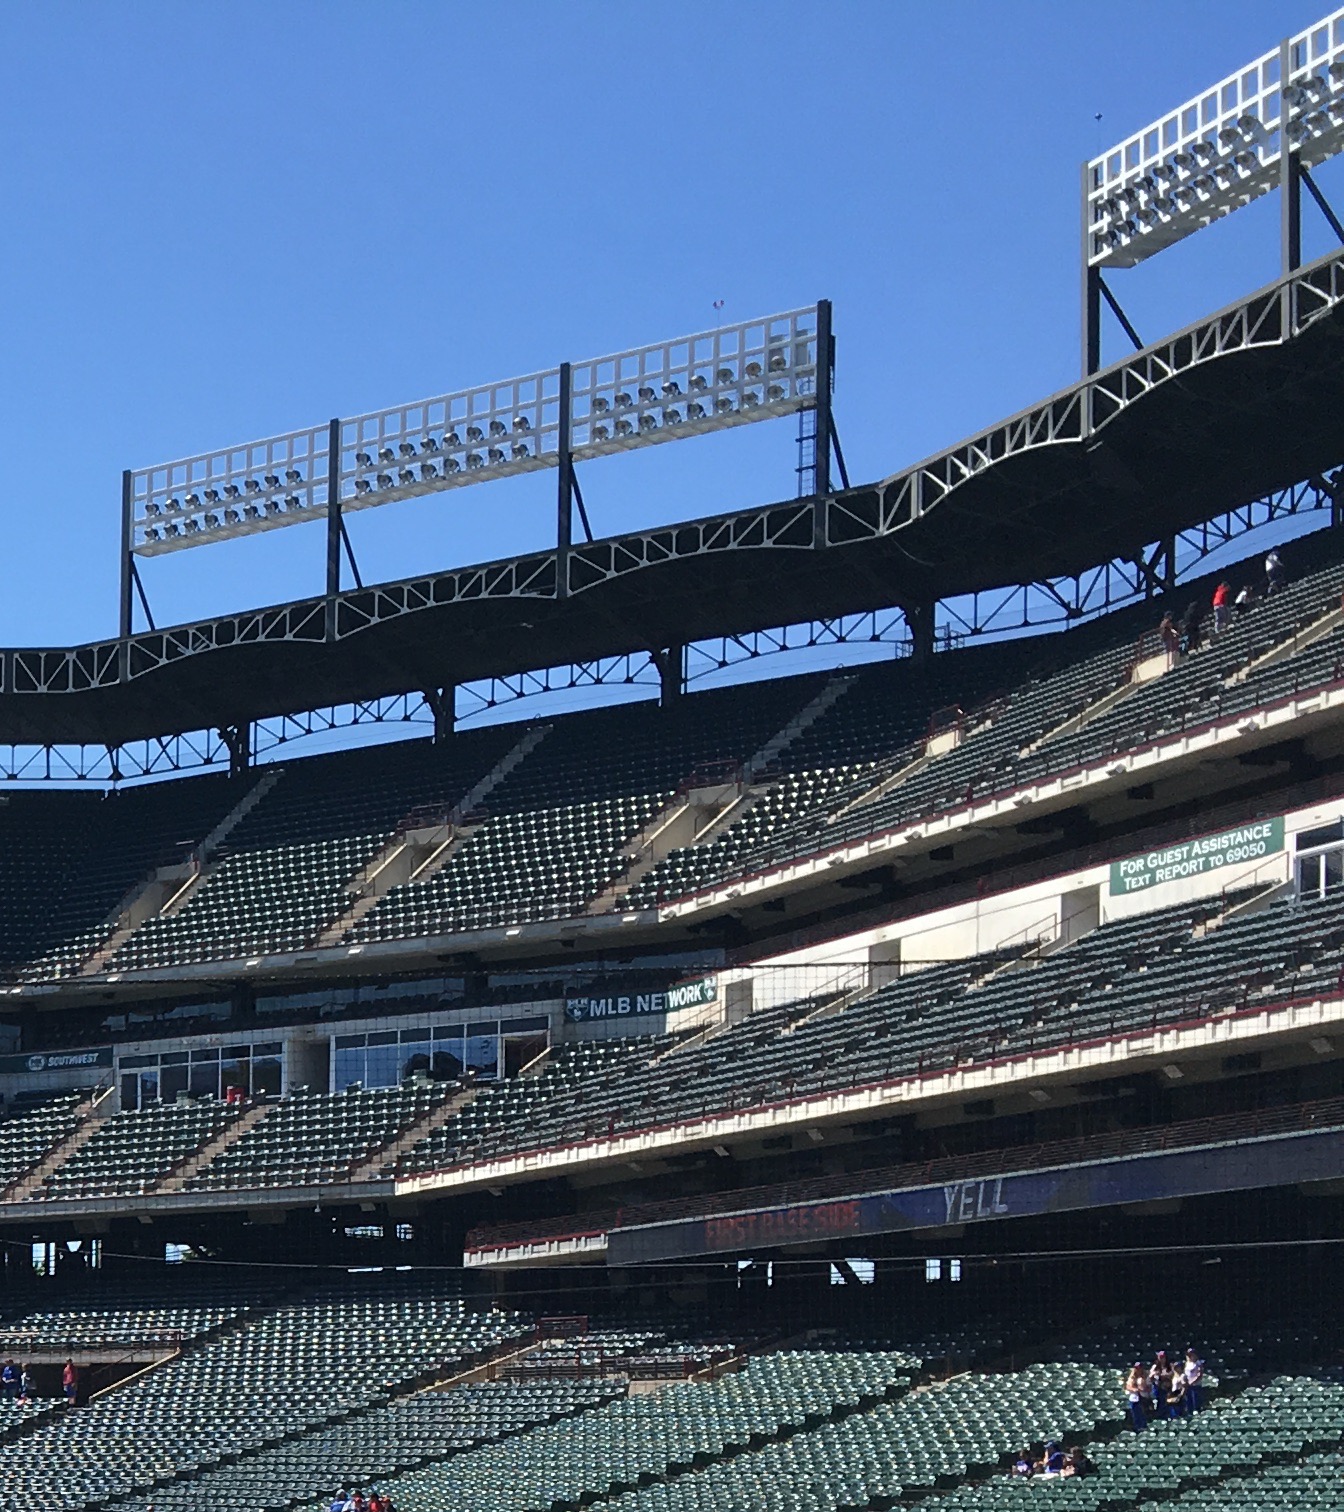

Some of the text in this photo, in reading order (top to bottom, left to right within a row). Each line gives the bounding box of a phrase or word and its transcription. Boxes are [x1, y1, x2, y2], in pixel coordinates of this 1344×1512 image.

[1120, 823, 1273, 877] FOR GUEST ASSISTANCE
[1123, 841, 1267, 891] TEXT REPORT TO 69050
[589, 982, 704, 1017] MLB NETWORK
[47, 1052, 99, 1067] SOUTHWEST
[942, 1177, 1009, 1223] YELL
[705, 1215, 758, 1247] FIRST
[815, 1200, 862, 1231] SIDE
